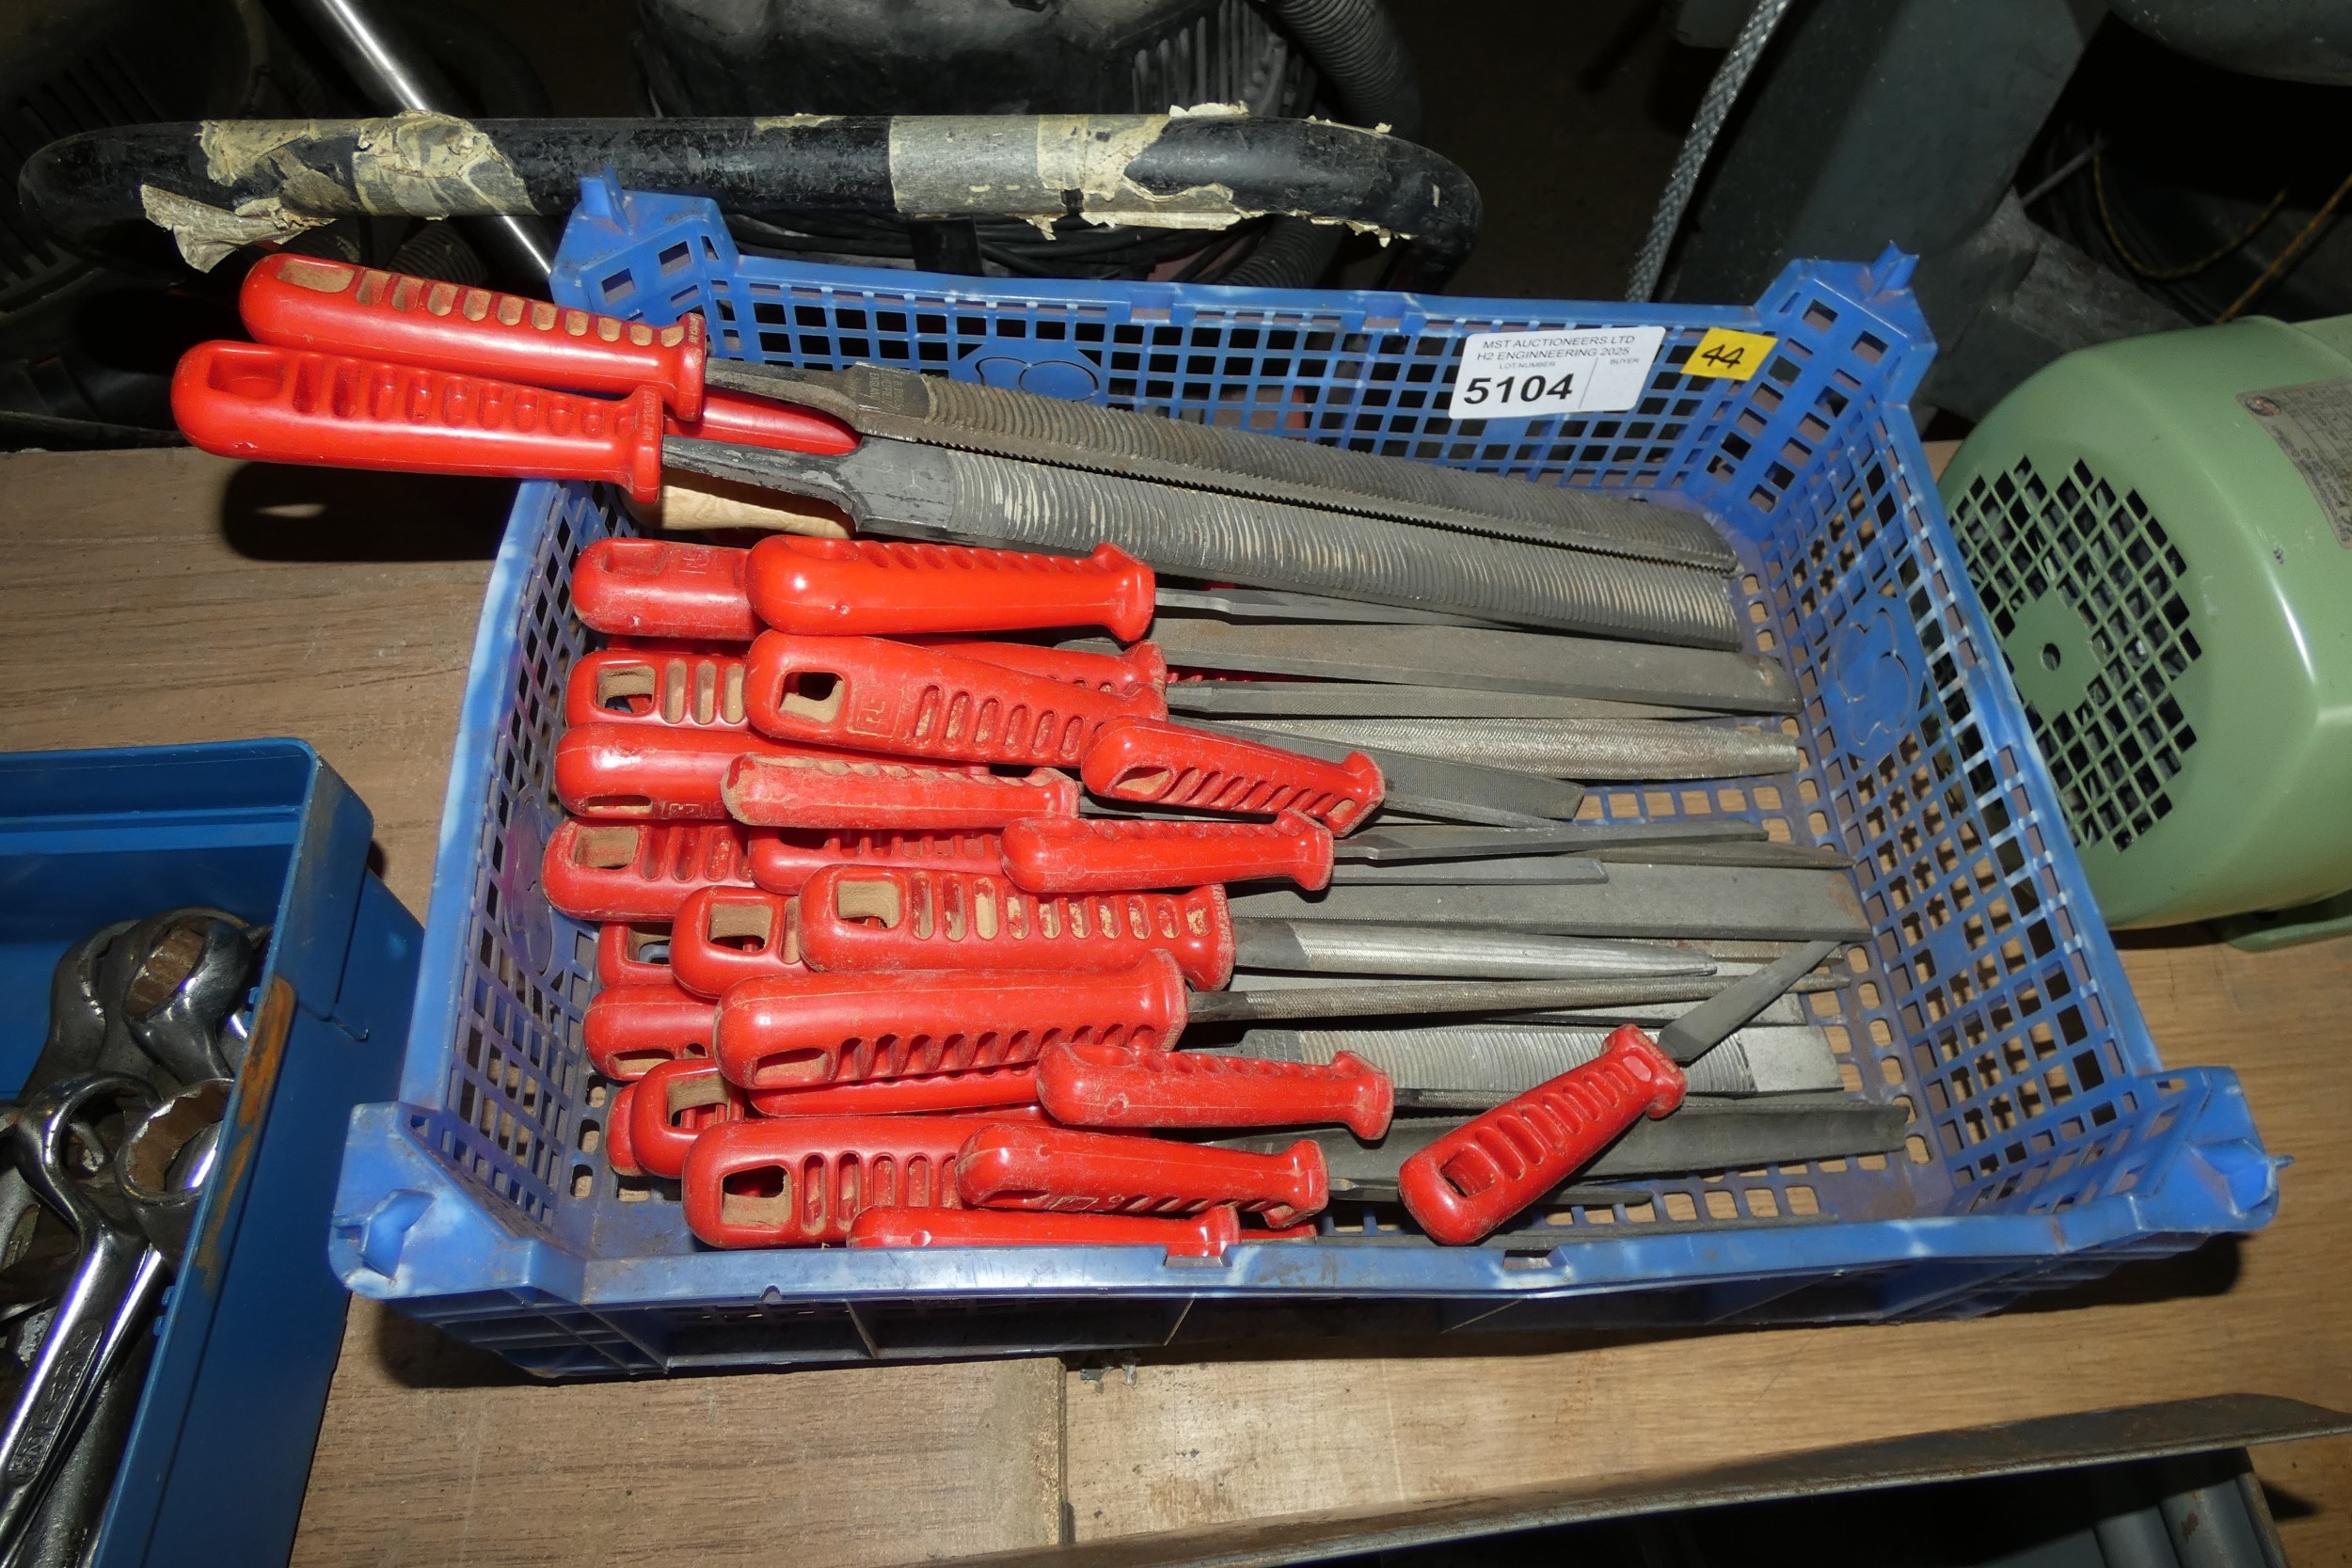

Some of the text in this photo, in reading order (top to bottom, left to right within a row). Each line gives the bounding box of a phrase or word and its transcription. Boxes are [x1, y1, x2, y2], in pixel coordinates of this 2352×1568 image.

[1483, 335, 1635, 349] MST AUCTIONEERS LTD
[1477, 347, 1629, 360] H2 ENGINNEERING 2025
[1701, 344, 1745, 369] 44
[1518, 360, 1556, 369] NUMBER
[1464, 373, 1574, 404] 5104
